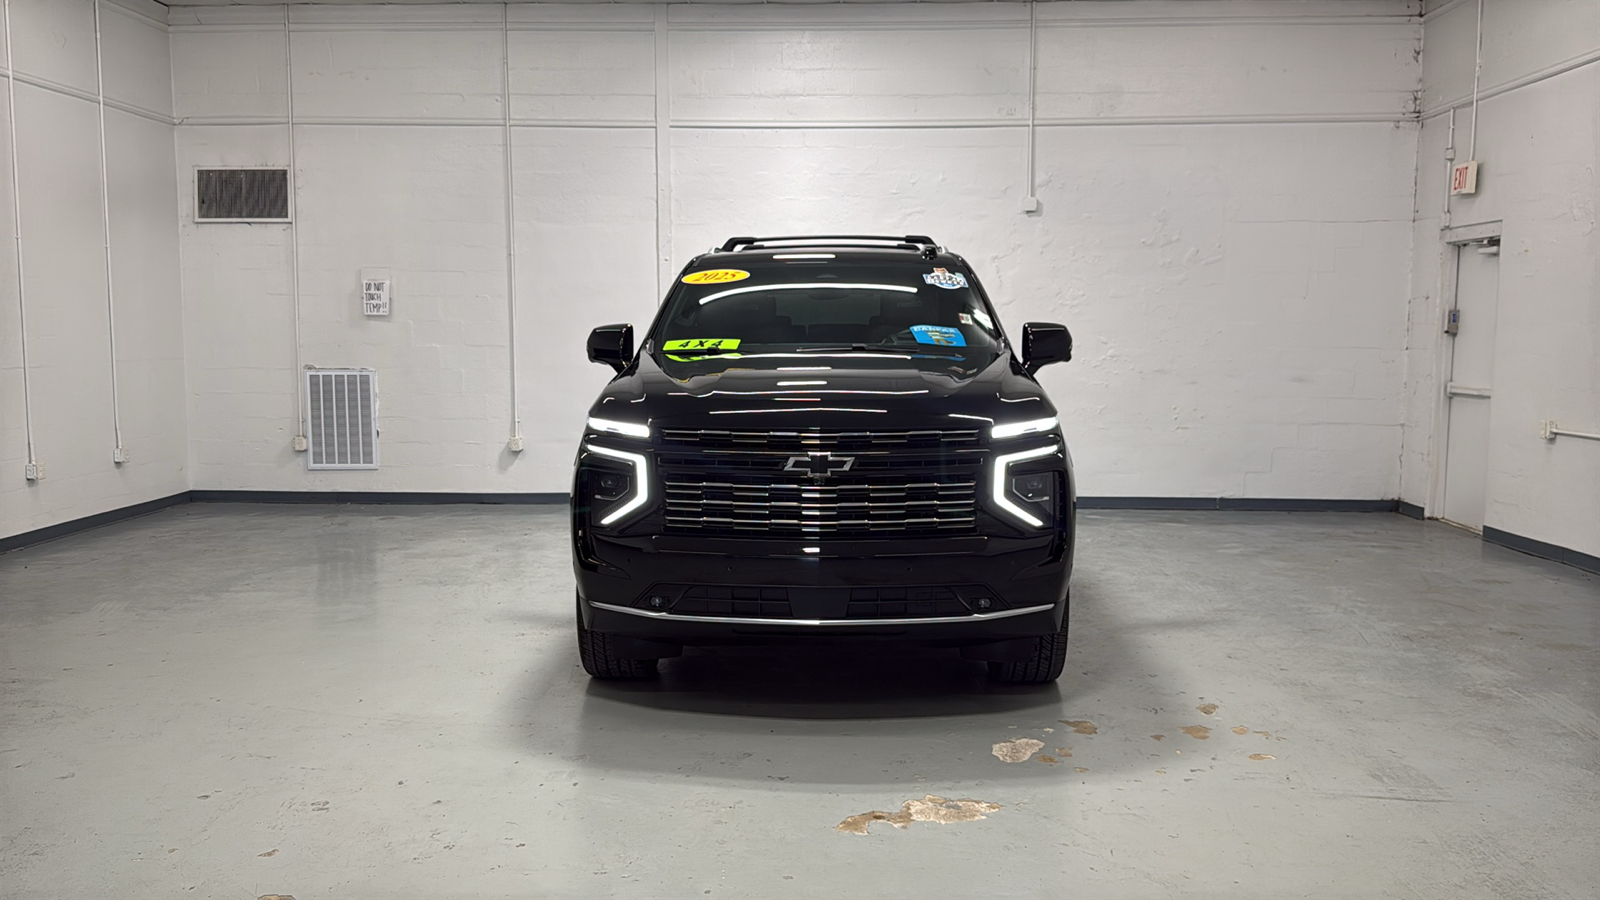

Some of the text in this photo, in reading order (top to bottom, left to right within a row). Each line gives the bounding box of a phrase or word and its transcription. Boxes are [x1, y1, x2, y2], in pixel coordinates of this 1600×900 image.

[1453, 166, 1469, 190] EXIT
[692, 271, 741, 282] 2025
[365, 282, 386, 292] DO NOT
[364, 292, 382, 302] TOUCH
[365, 302, 387, 313] TEMP!!
